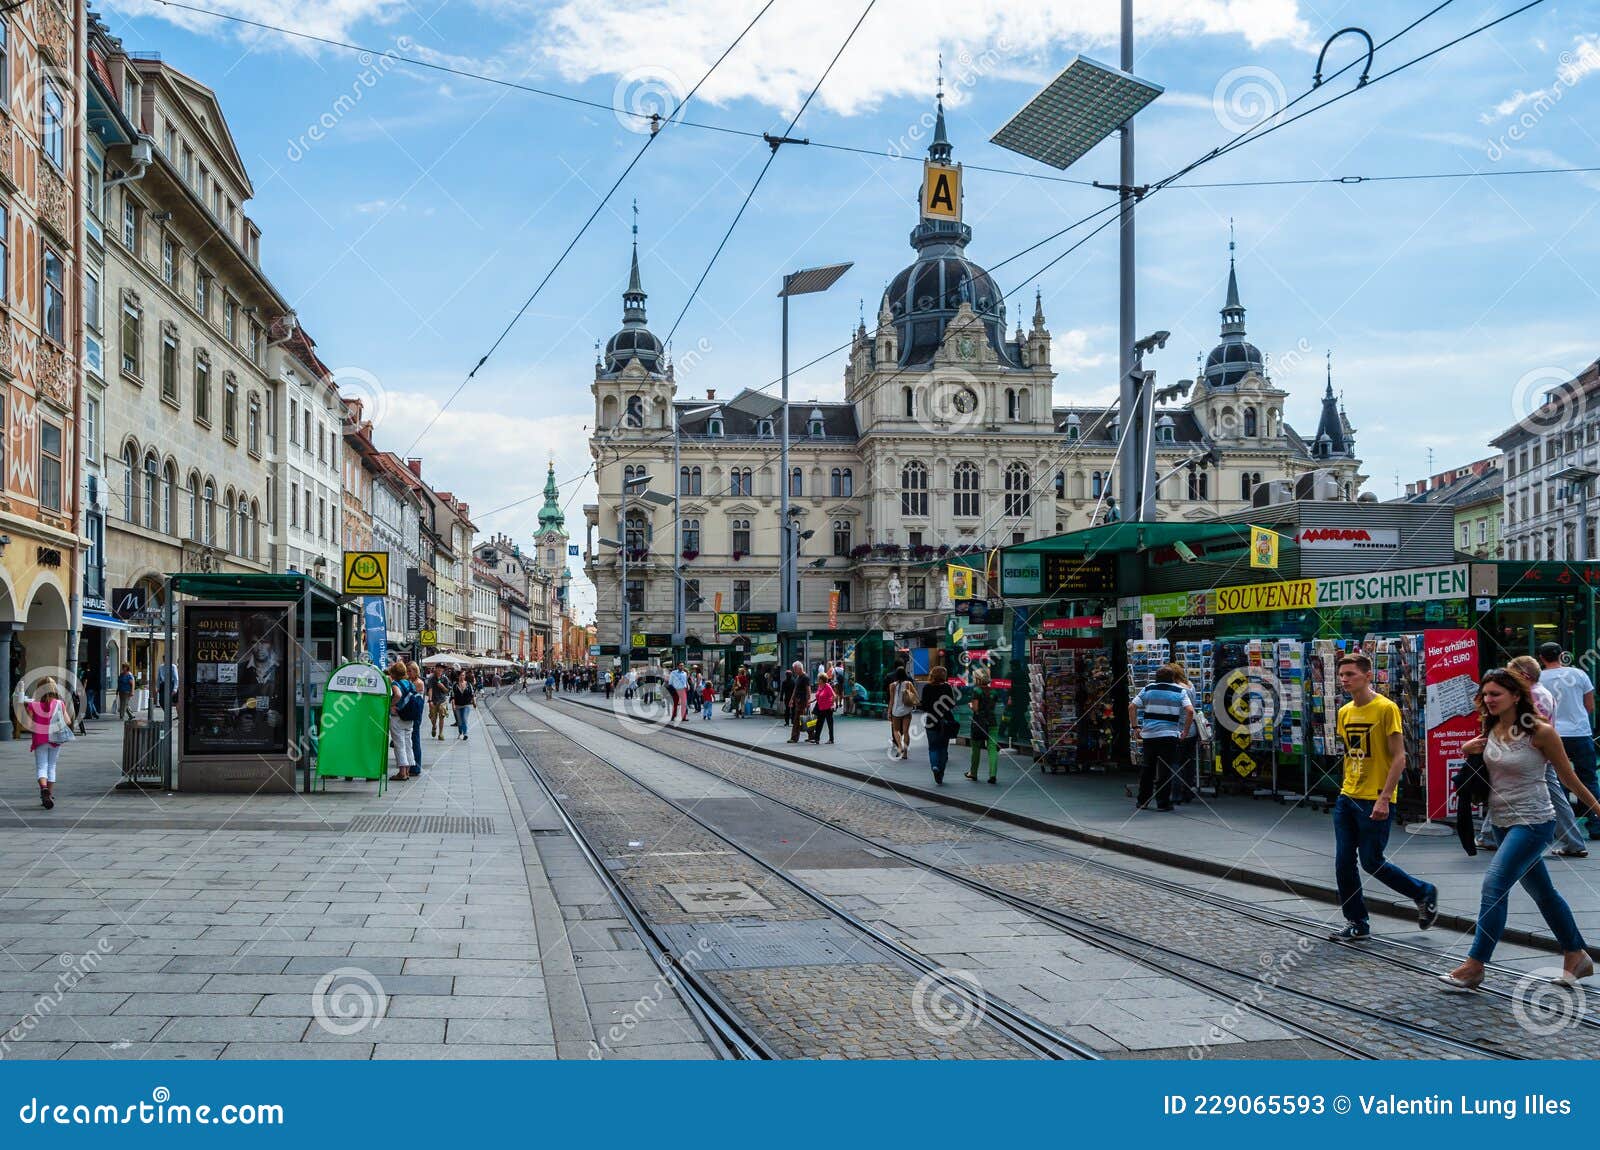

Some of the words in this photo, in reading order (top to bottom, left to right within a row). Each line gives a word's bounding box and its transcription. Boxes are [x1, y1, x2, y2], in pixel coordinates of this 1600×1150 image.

[930, 174, 953, 211] A
[1302, 528, 1371, 543] MORAWA
[1318, 569, 1466, 602] ZEITSCHRIFTEN
[1218, 582, 1312, 610] SOUVENIR
[210, 620, 240, 630] JAHRE
[1428, 646, 1443, 656] Hier
[1444, 638, 1476, 652] erhältlich
[197, 650, 239, 661] GRAZ
[1453, 652, 1470, 664] EURO
